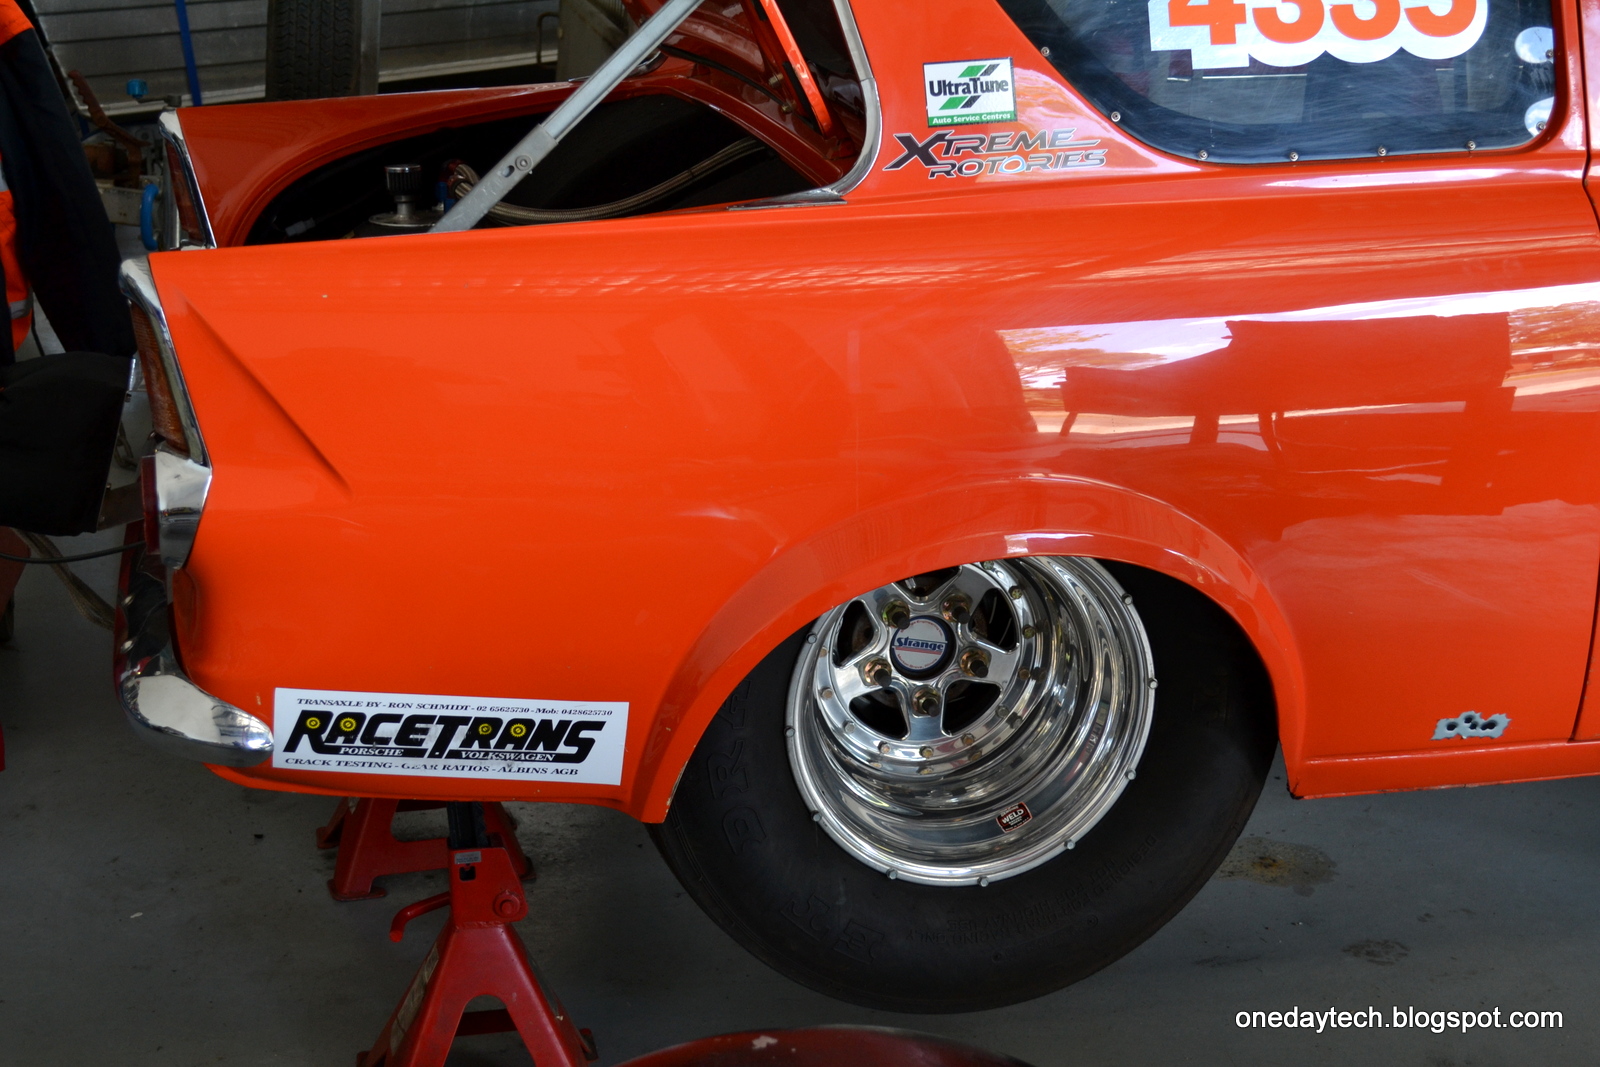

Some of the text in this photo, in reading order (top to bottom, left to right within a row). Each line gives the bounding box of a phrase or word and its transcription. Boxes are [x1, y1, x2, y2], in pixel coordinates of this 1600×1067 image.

[932, 117, 952, 125] Auto
[953, 115, 980, 123] Service
[882, 128, 1101, 171] XTREME
[928, 149, 1108, 179] ROTORIES
[896, 637, 944, 651] Strange
[297, 698, 364, 708] TRANSAXLE
[415, 703, 471, 711] SCHMIDT
[339, 747, 556, 762] PORSCHE VOLKSWAGEN
[285, 757, 332, 767] CRACK
[335, 760, 393, 769] TESTING
[441, 764, 490, 772] RATIOS
[498, 765, 548, 775] ALBINS
[551, 768, 579, 776] AGB
[1002, 808, 1024, 824] WELD
